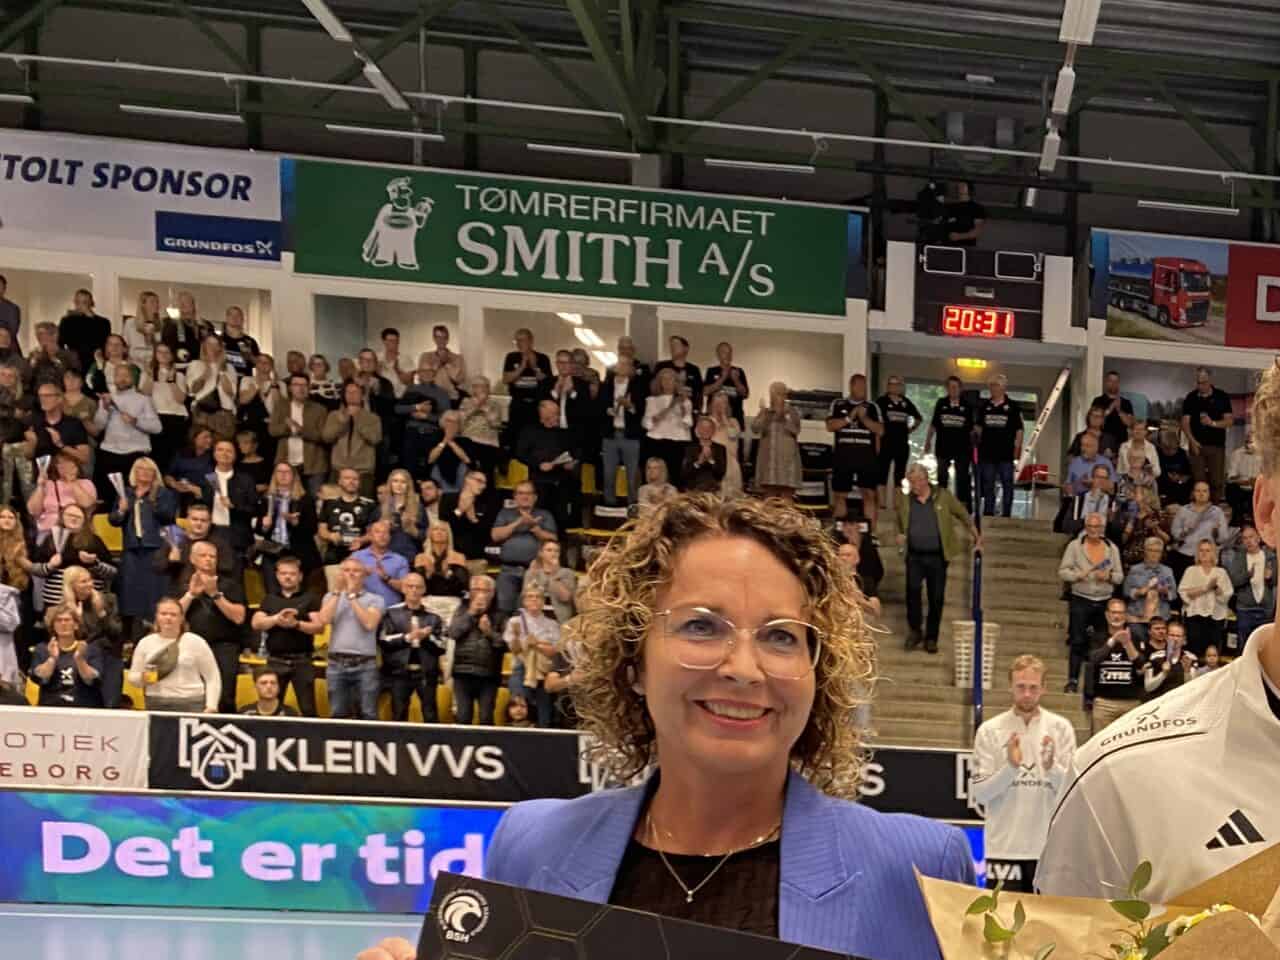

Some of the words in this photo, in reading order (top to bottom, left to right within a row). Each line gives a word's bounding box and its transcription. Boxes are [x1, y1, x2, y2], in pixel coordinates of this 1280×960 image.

[0, 153, 83, 186] TOLT
[91, 160, 252, 201] SPONSOR
[455, 184, 776, 236] TØMRERFIRMAET
[163, 236, 255, 254] GRUNDFOS
[455, 221, 684, 290] SMITH
[698, 239, 776, 304] A/S
[945, 308, 1011, 335] 20:31
[1100, 716, 1198, 746] GRUNDFOS
[0, 761, 121, 781] EBORG
[267, 736, 398, 775] KLEIN
[407, 742, 506, 781] VVS
[41, 820, 214, 880] Det
[240, 840, 337, 883] er
[359, 829, 486, 886] tid
[445, 929, 471, 944] BSH
